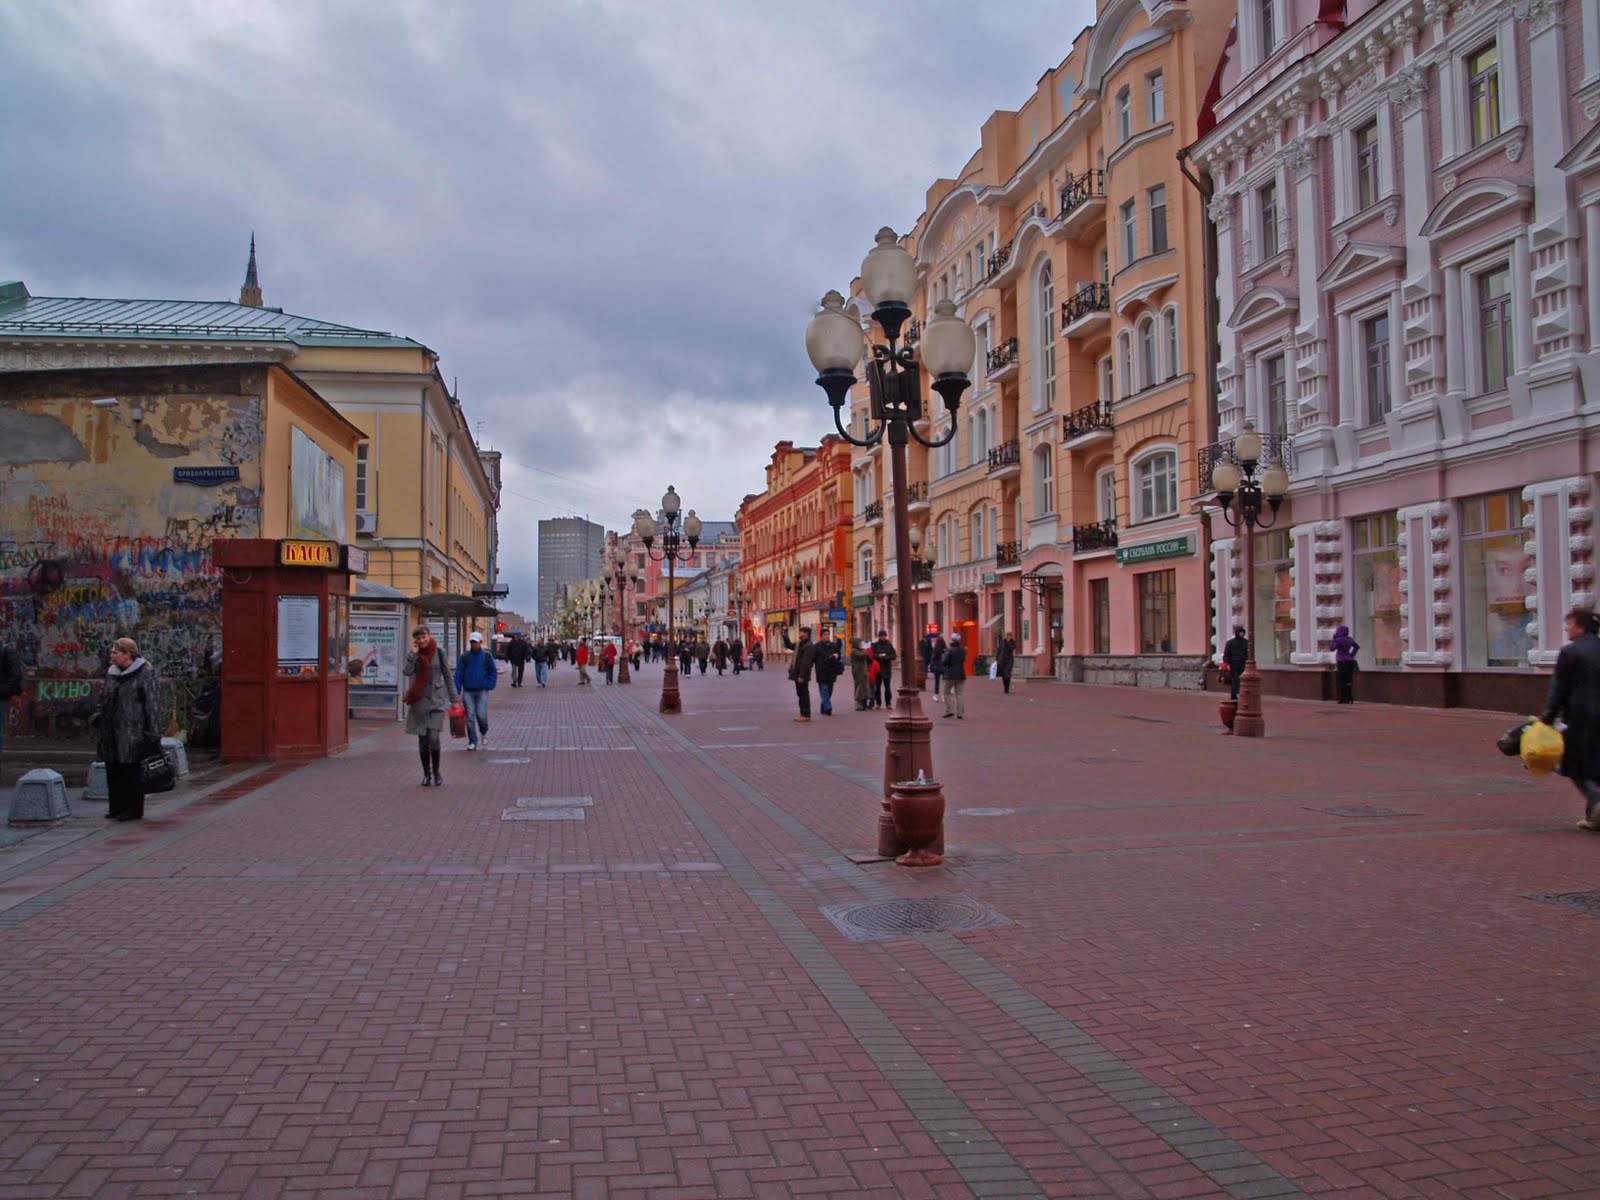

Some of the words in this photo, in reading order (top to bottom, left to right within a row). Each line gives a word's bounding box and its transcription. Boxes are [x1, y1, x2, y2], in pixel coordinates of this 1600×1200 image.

[286, 544, 333, 562] КАССА
[1129, 546, 1155, 557] СБЕРБАНК
[1156, 542, 1179, 553] РОССИИ
[36, 681, 92, 701] КИНО
